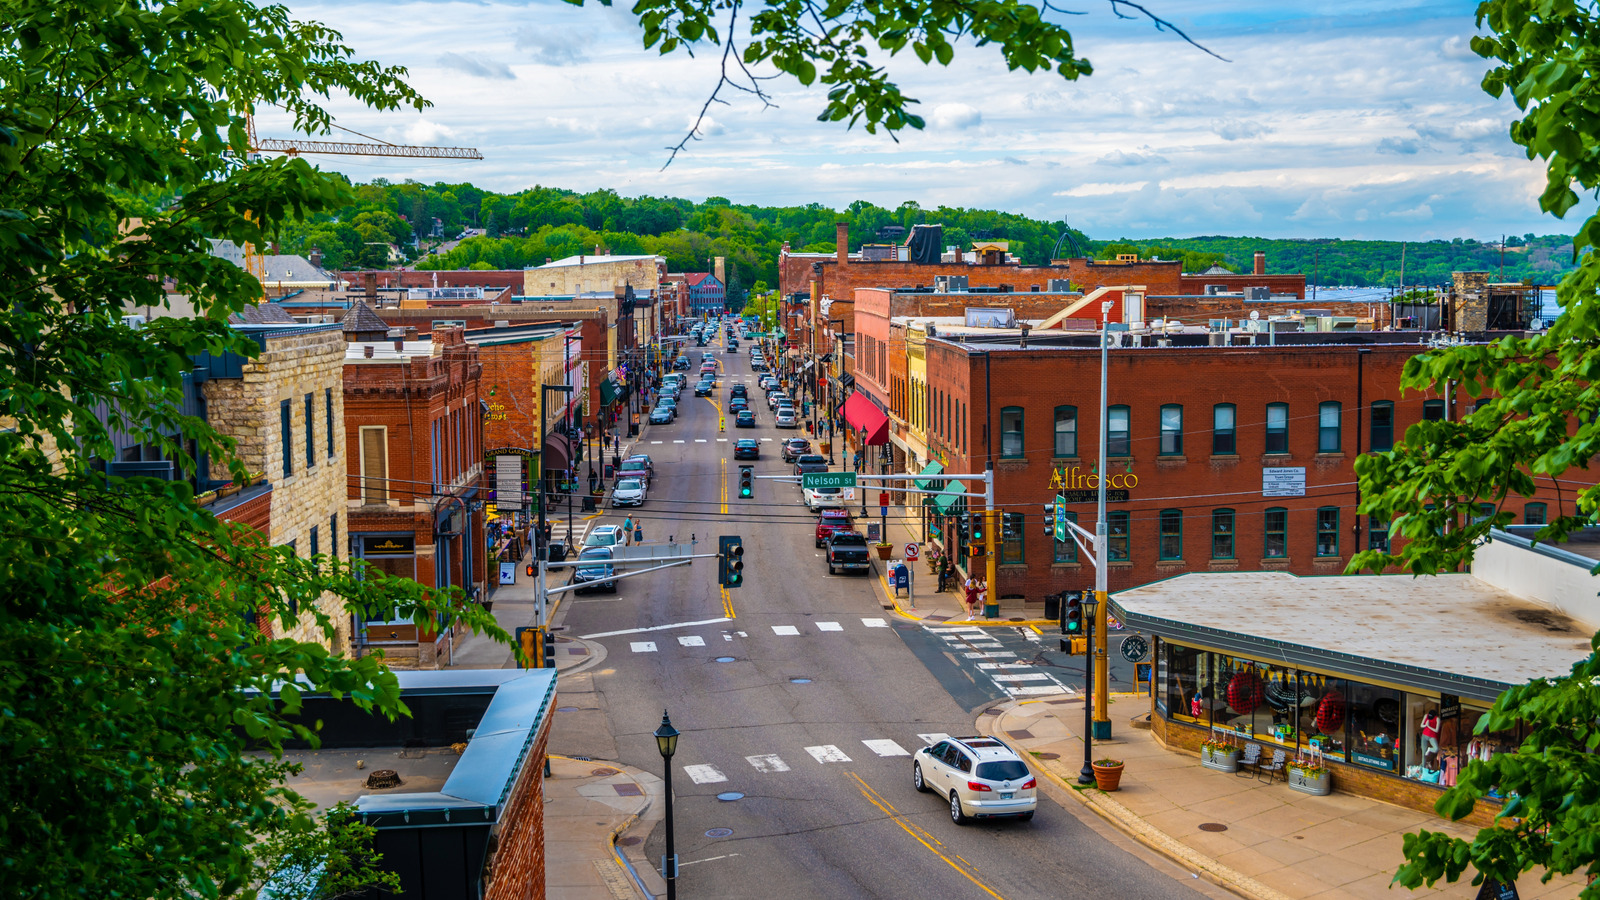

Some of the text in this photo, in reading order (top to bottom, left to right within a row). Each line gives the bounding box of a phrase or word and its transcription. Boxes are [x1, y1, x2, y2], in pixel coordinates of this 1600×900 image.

[486, 448, 531, 457] GRAND GARAGE
[807, 476, 852, 485] Nelson St
[1047, 466, 1139, 490] Alfresco
